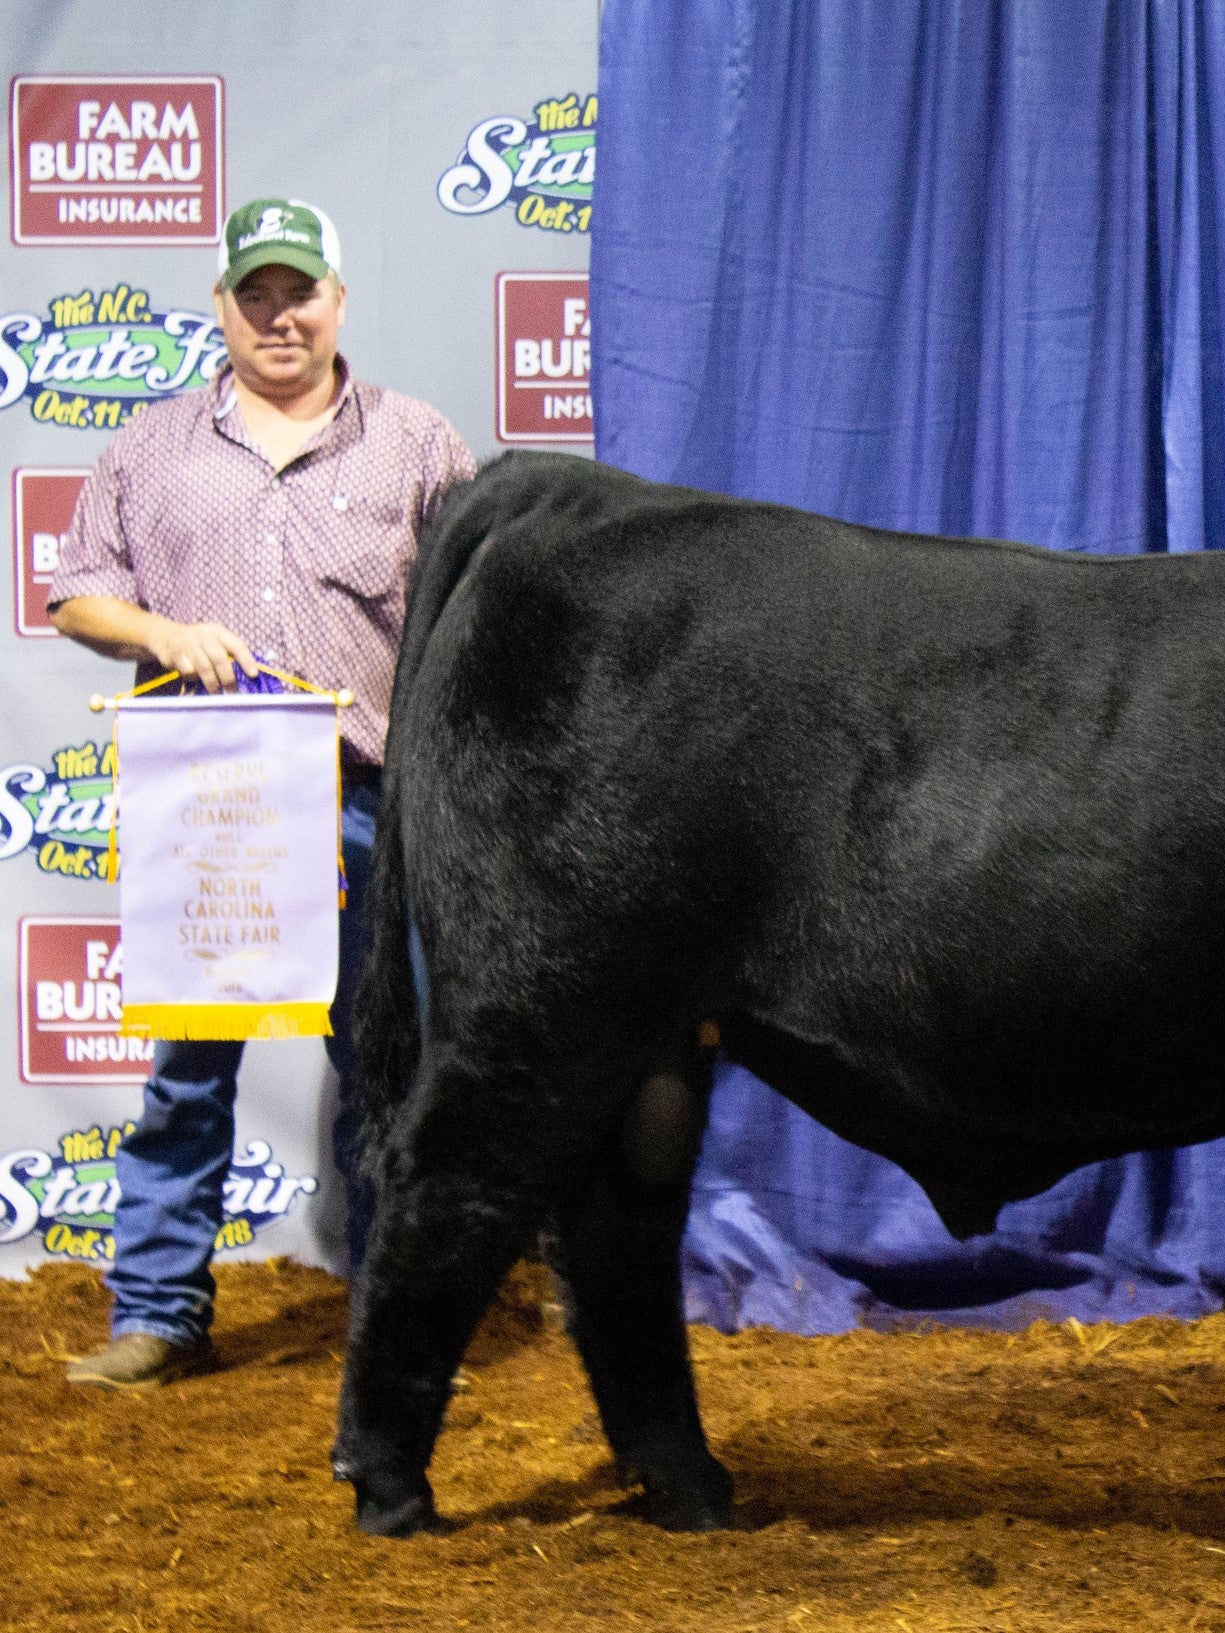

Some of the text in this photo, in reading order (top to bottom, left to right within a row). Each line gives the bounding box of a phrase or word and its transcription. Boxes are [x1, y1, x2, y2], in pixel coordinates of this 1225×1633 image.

[77, 100, 200, 140] FARM
[29, 141, 201, 181] BUREAU
[58, 197, 201, 223] INSURANCE
[98, 285, 151, 323] N.C.
[0, 312, 158, 410] State
[179, 806, 279, 827] CHAMPION
[199, 877, 261, 897] NORTH
[183, 899, 277, 919] CAROLINA
[179, 924, 281, 945] STATE FAIR
[222, 1140, 317, 1214] air
